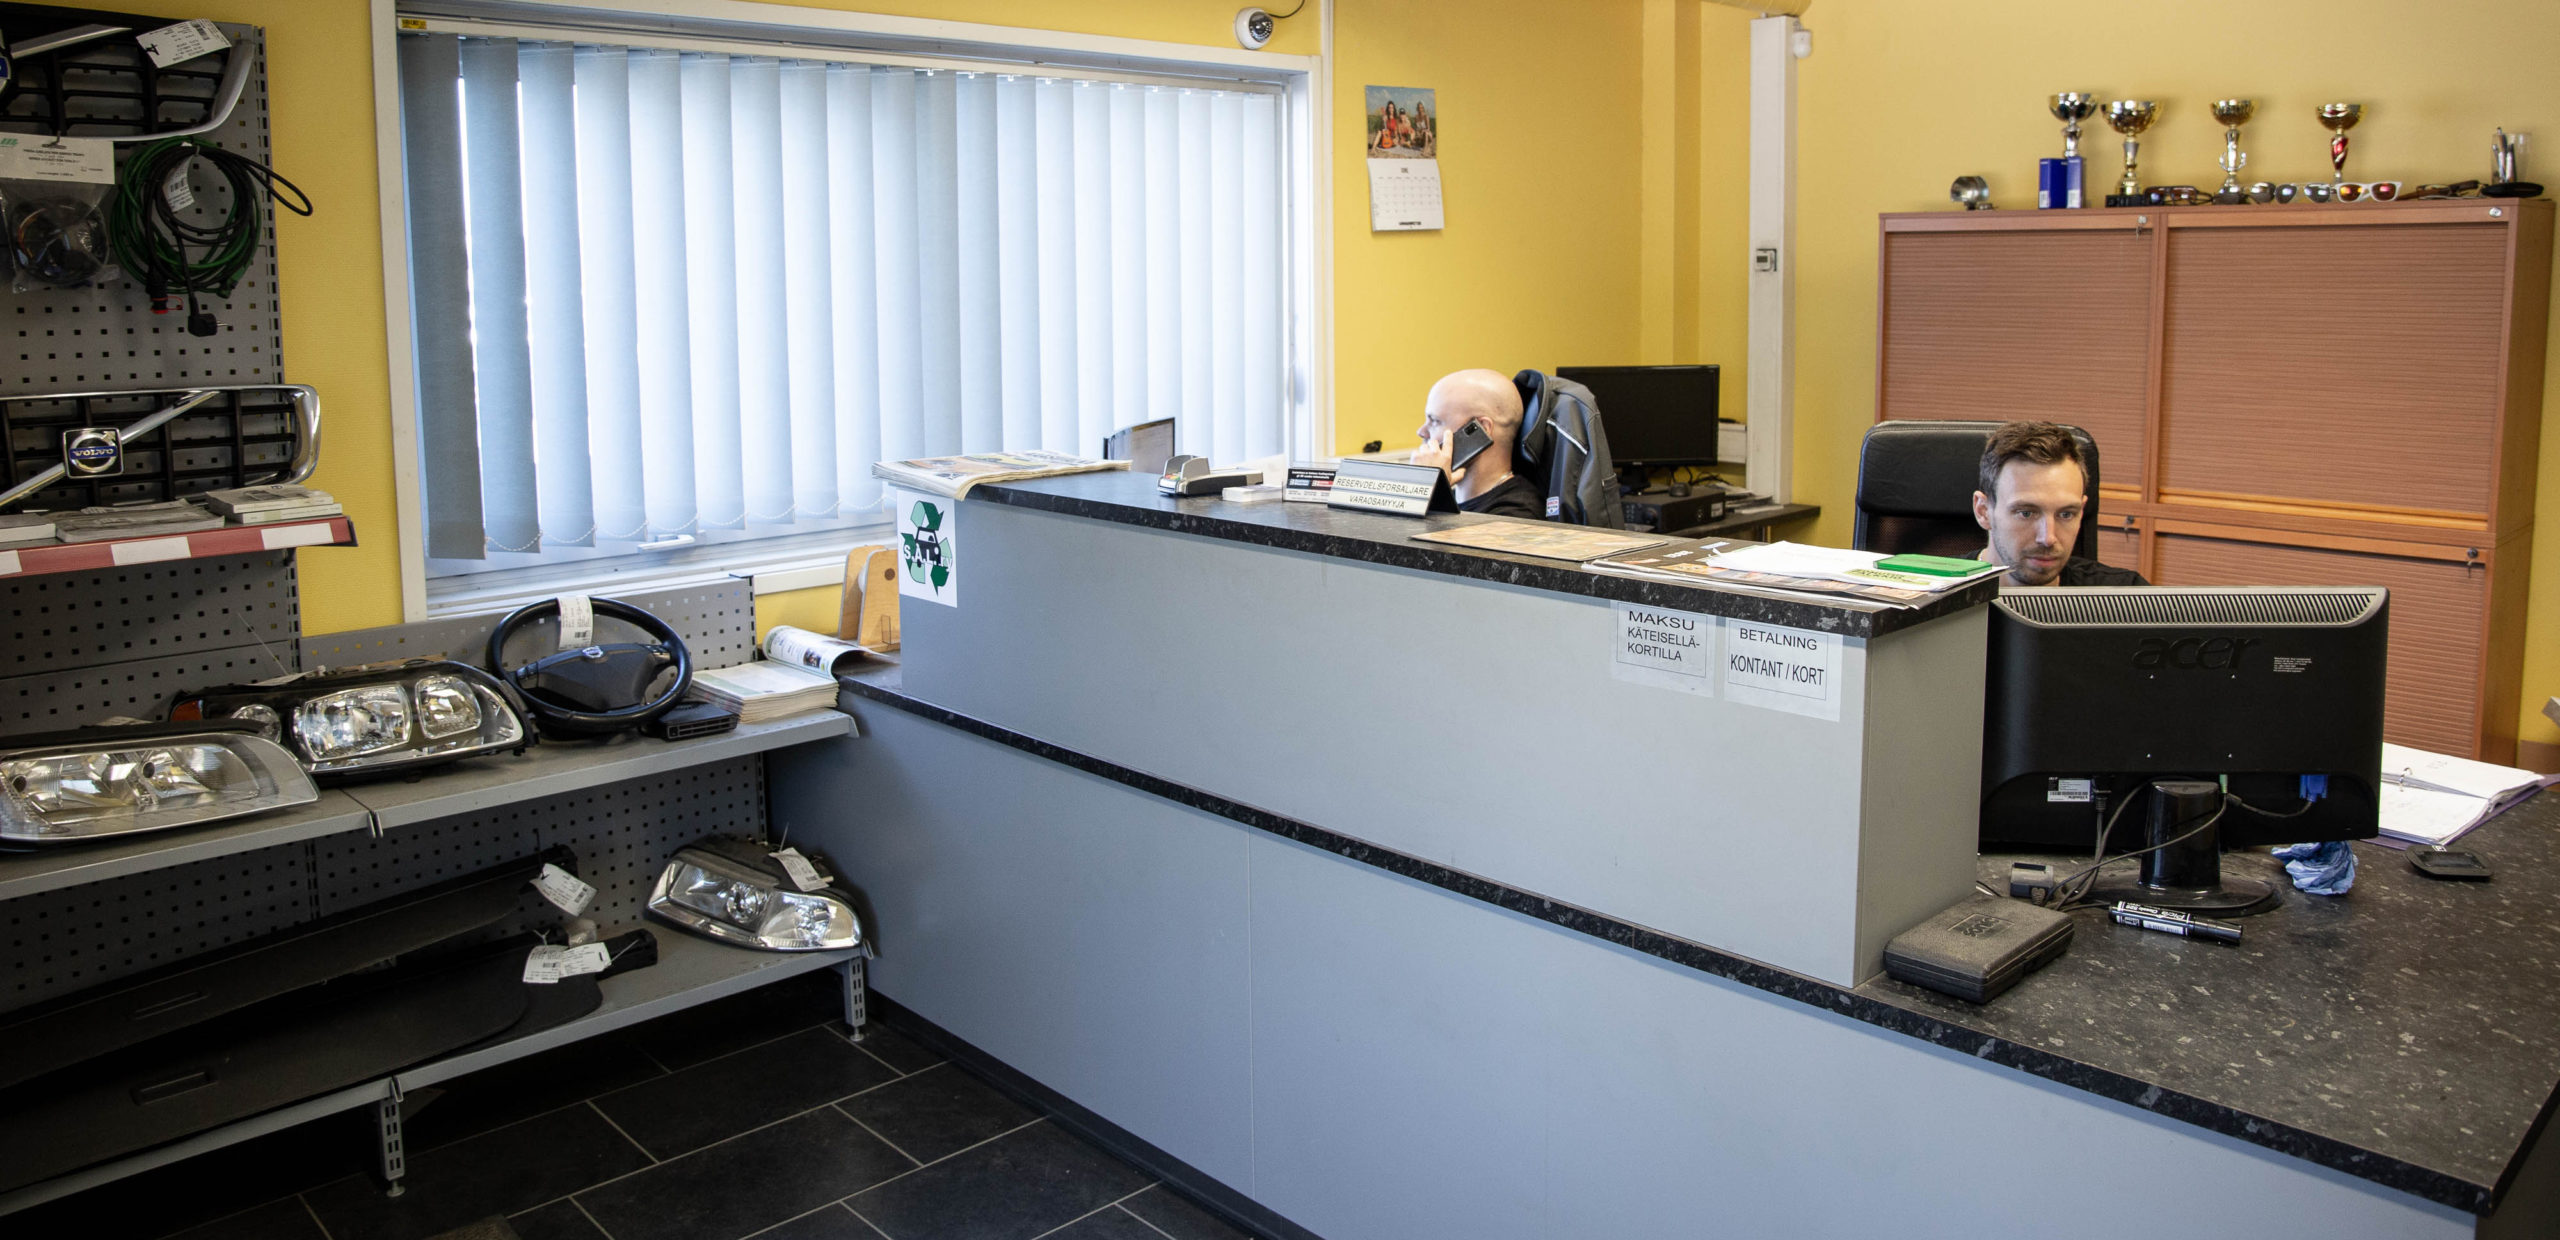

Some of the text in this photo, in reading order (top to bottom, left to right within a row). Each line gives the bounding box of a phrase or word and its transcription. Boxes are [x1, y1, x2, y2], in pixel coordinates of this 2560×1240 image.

[72, 448, 114, 457] VOLVO
[1628, 610, 1695, 631] MAKSU
[1627, 626, 1701, 648] KÄTEISELLÄ-
[1739, 627, 1818, 651] BETALNING
[1627, 642, 1682, 662] KORTILLA
[2131, 636, 2262, 669] acer
[1730, 653, 1825, 686] KONTANT / KORT
